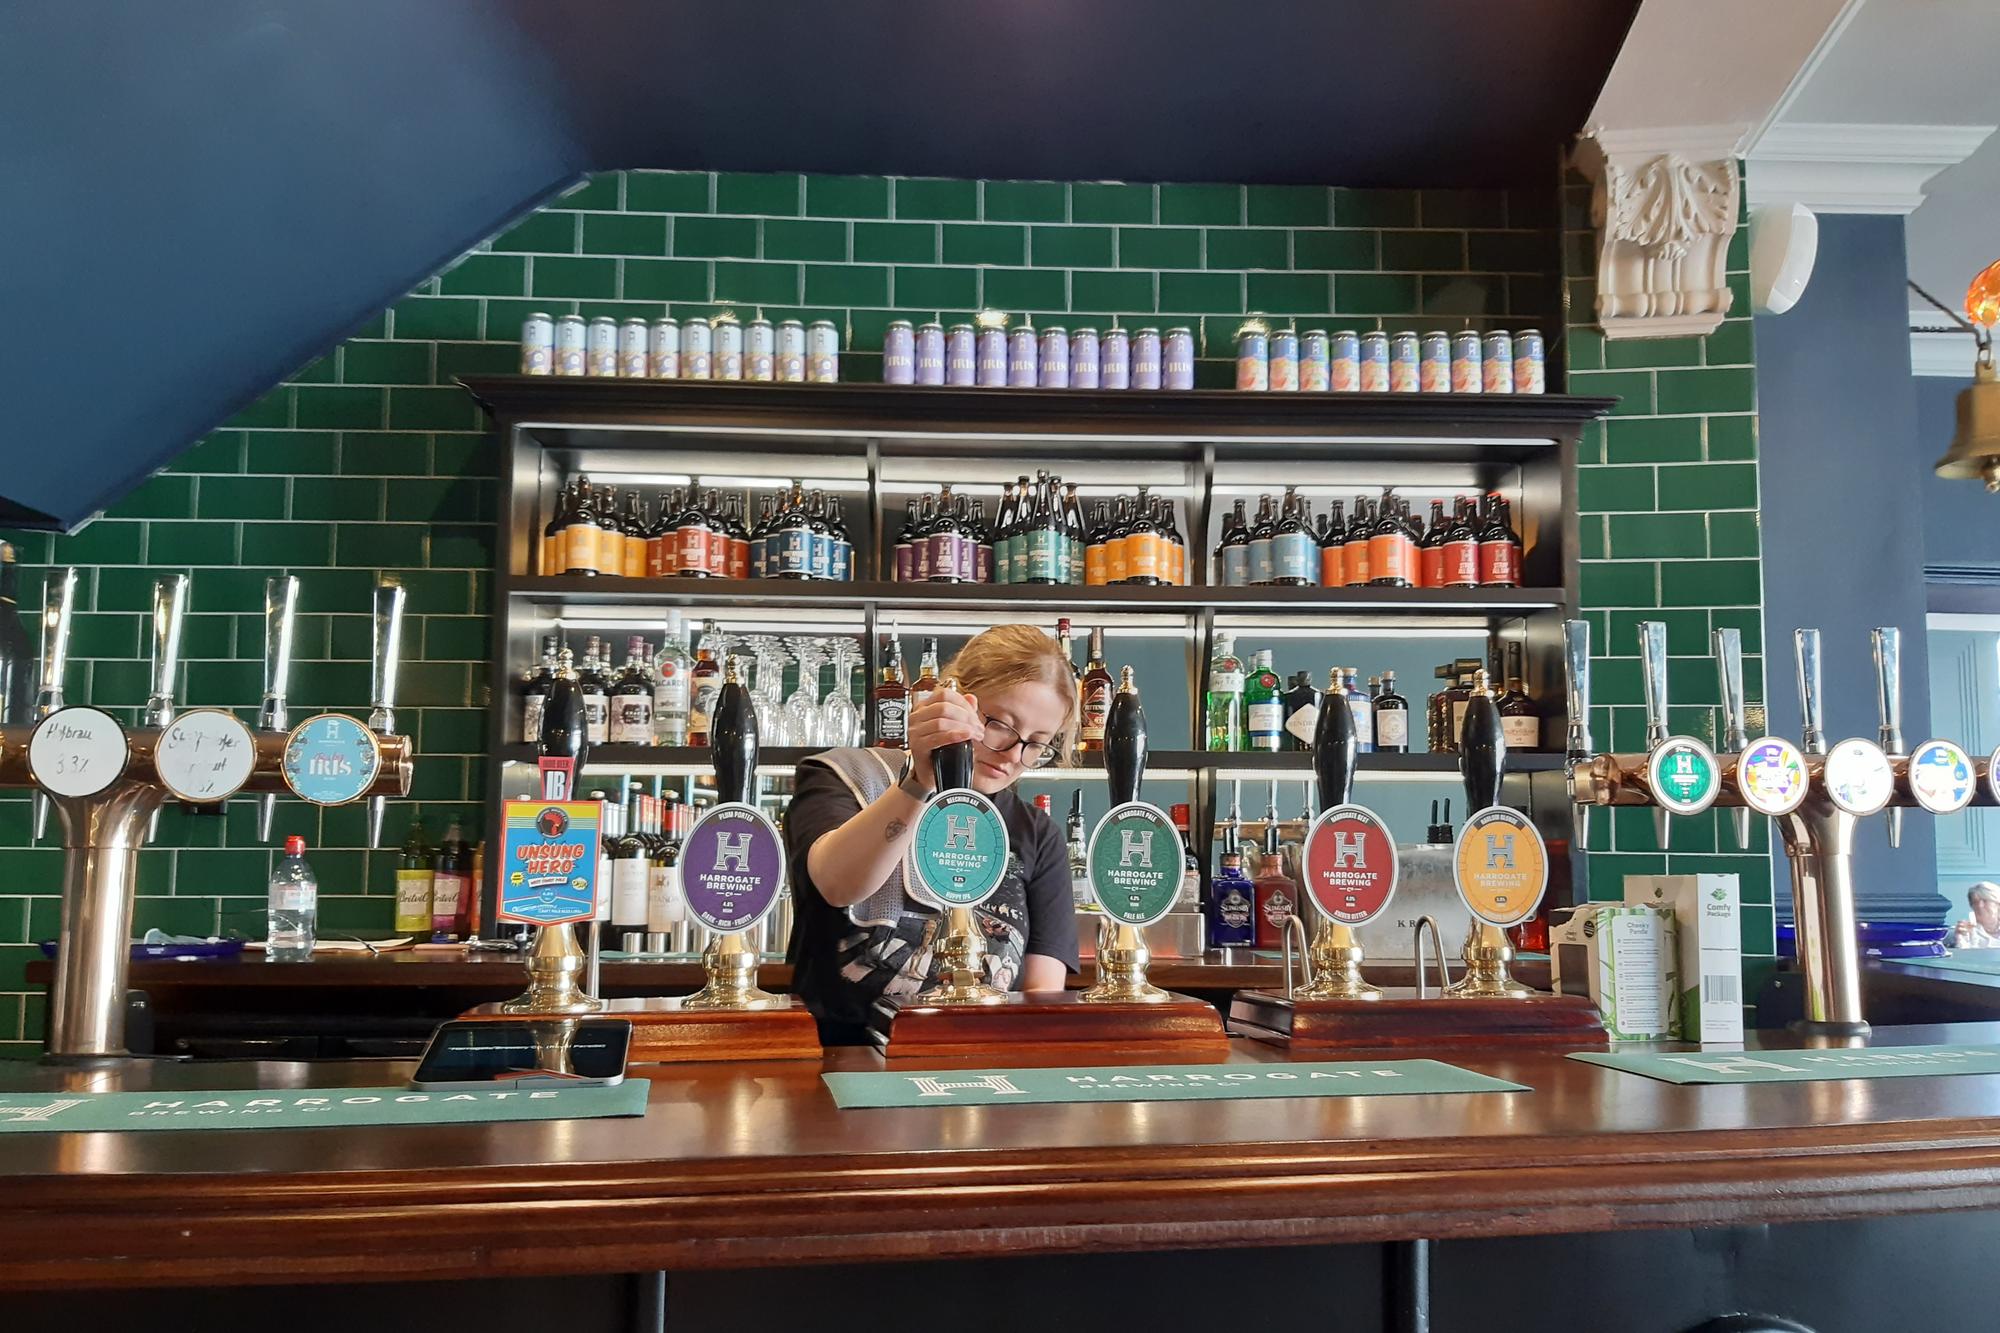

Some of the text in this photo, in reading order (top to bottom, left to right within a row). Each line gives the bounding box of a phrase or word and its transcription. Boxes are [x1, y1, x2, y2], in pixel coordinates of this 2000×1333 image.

[46, 722, 92, 742] Hfbrau
[734, 811, 754, 822] PORTER
[944, 814, 978, 850] H
[516, 844, 585, 861] UNSUNG
[712, 831, 753, 872] H
[1119, 829, 1153, 867] H
[1334, 831, 1366, 868] H
[1485, 833, 1515, 869] H
[932, 851, 988, 862] HARROGATE
[528, 859, 573, 875] HERO
[938, 859, 981, 868] BREWING
[700, 873, 761, 885] HARROGATE
[1107, 870, 1163, 879] HARROGATE
[1323, 871, 1378, 880] HARROGATE
[706, 881, 753, 891] BREWING
[1114, 877, 1157, 886] BREWING
[1329, 879, 1371, 887] BREWING
[1221, 904, 1250, 913] SLINGSBY
[1263, 903, 1293, 913] SLINGSBY
[1706, 903, 1732, 912] Comfy
[1066, 1069, 1403, 1083] HARROGATE
[904, 1075, 1030, 1096] H
[143, 1090, 560, 1109] HARROGATE
[127, 1107, 283, 1116] BREWING
